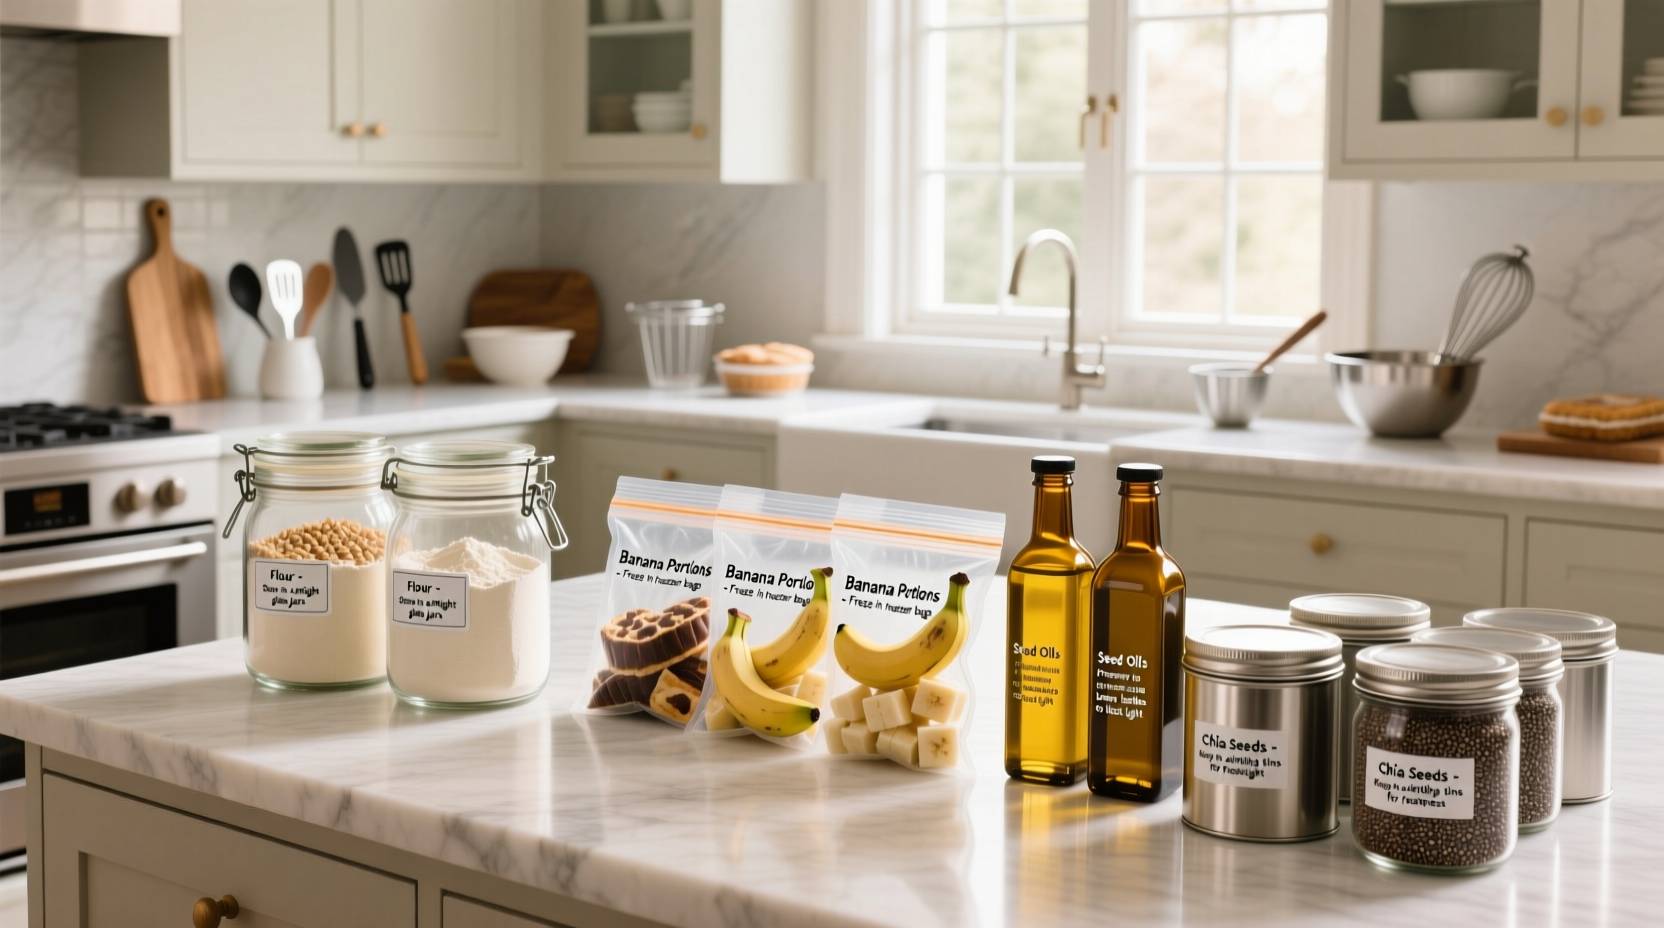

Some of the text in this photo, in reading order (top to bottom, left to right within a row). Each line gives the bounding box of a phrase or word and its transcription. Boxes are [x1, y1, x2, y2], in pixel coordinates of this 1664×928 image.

[619, 549, 664, 570] Banana
[408, 581, 432, 593] Flour
[725, 564, 815, 590] Banana Portio
[845, 575, 895, 596] Banana
[875, 600, 883, 610] in
[1202, 734, 1226, 749] Chia
[1229, 738, 1267, 753] Seeds
[1378, 762, 1405, 778] Chia
[1408, 767, 1448, 782] Seeds
